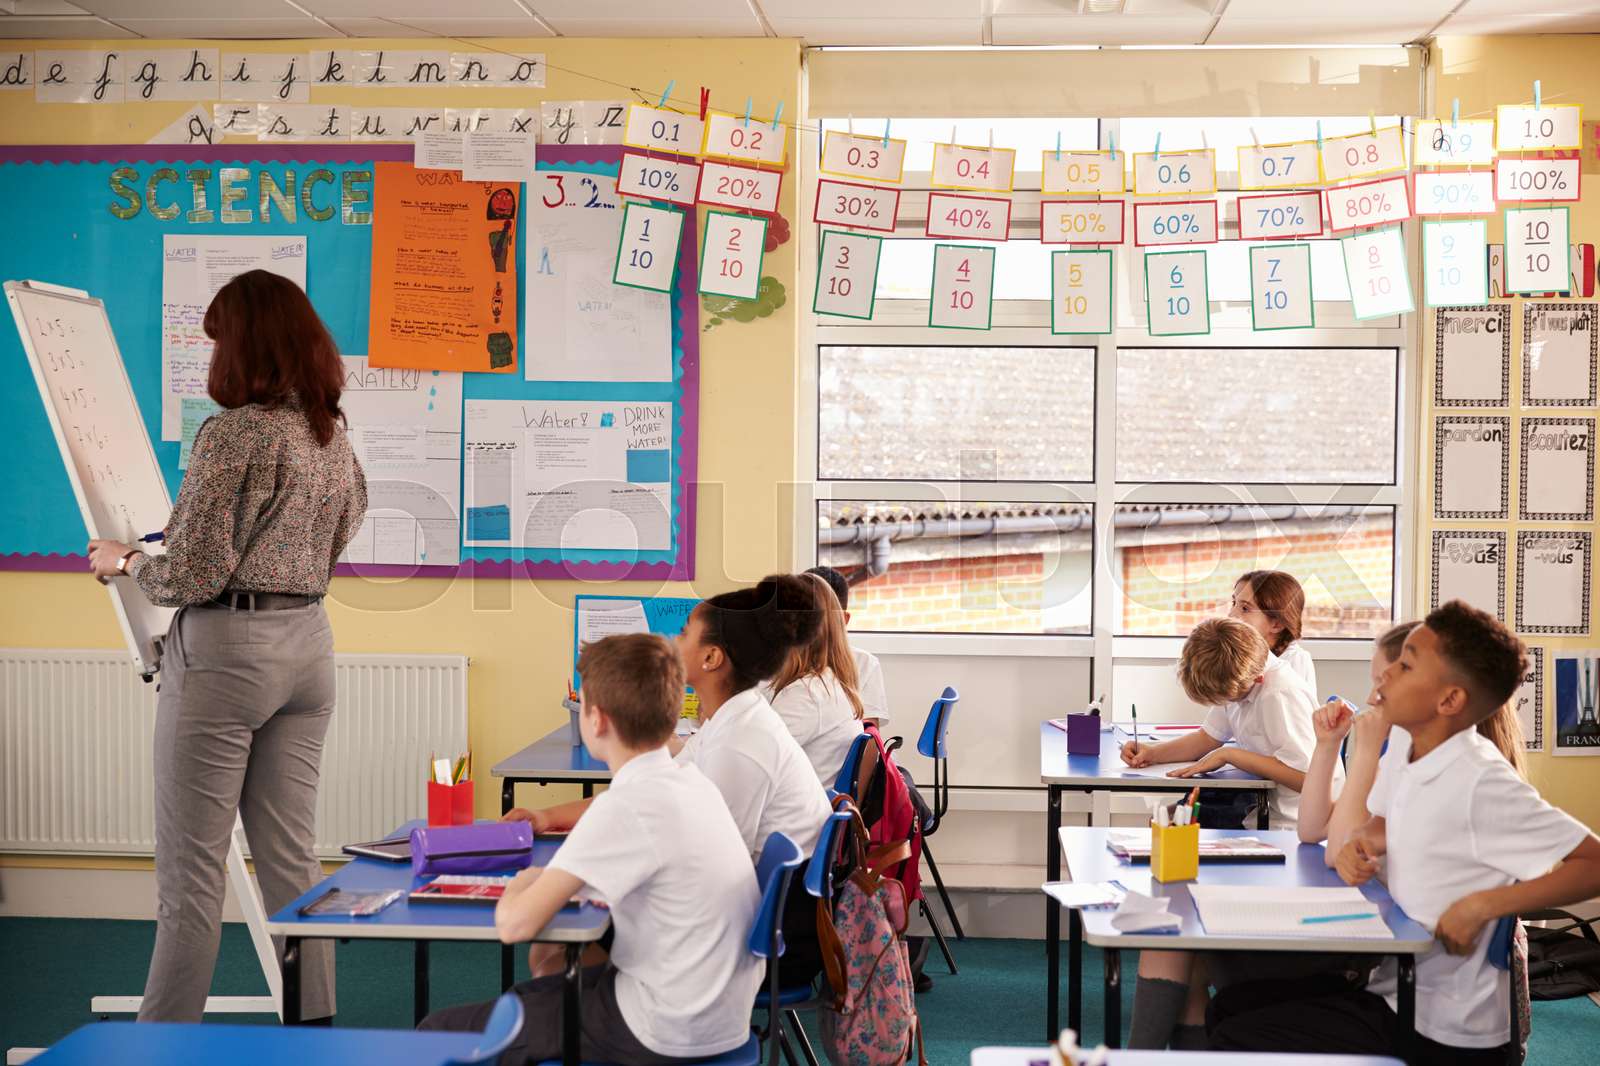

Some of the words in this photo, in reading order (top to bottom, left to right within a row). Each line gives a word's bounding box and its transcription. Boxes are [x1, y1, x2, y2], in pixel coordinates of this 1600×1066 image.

[43, 62, 67, 83] e
[134, 61, 160, 98] g
[183, 50, 212, 82] h
[231, 57, 250, 82] i
[279, 58, 297, 98] j
[320, 51, 345, 83] k
[409, 61, 446, 82] m
[459, 58, 488, 82] n
[510, 61, 537, 82] o
[321, 108, 339, 136] t
[358, 116, 385, 136] u
[549, 109, 575, 144] y
[652, 119, 680, 141] 0.1
[1524, 118, 1554, 138] 1.0
[730, 129, 763, 150] 0.2
[847, 147, 880, 169] 0.3
[1345, 143, 1379, 168] 0.8
[956, 158, 990, 179] 0.4
[1067, 163, 1100, 183] 0.5
[1158, 164, 1191, 184] 0.6
[1262, 157, 1295, 177] 0.7
[638, 167, 680, 192] 10%
[716, 176, 762, 200] 20%
[1510, 170, 1567, 191] 100%
[108, 168, 374, 225] SCIENCE
[1345, 191, 1392, 218] 80%
[1432, 184, 1480, 207] 90%
[834, 195, 879, 219] 30%
[1257, 206, 1305, 228] 70%
[641, 218, 650, 237] 1
[945, 208, 991, 230] 40%
[1058, 213, 1106, 234] 50%
[1153, 214, 1200, 235] 60%
[729, 228, 742, 247] 2
[1525, 221, 1549, 241] 10
[630, 248, 653, 270] 10
[838, 246, 850, 265] 3
[1367, 245, 1380, 265] 8
[1526, 253, 1550, 273] 10
[719, 258, 743, 279] 10
[957, 258, 971, 278] 4
[1069, 263, 1083, 284] 5
[1170, 264, 1183, 284] 6
[1267, 259, 1281, 277] 7
[828, 276, 852, 297] 10
[1367, 276, 1391, 297] 10
[950, 290, 974, 310] 10
[1064, 296, 1088, 315] 10
[1167, 296, 1190, 316] 10
[1264, 290, 1288, 310] 10
[1444, 313, 1503, 334] merci
[624, 406, 665, 427] DRINK
[633, 423, 660, 435] MORE
[1443, 424, 1502, 447] pardon
[1529, 426, 1587, 450] écoutez
[1440, 538, 1498, 553] levez
[1566, 735, 1600, 745] FRANC
